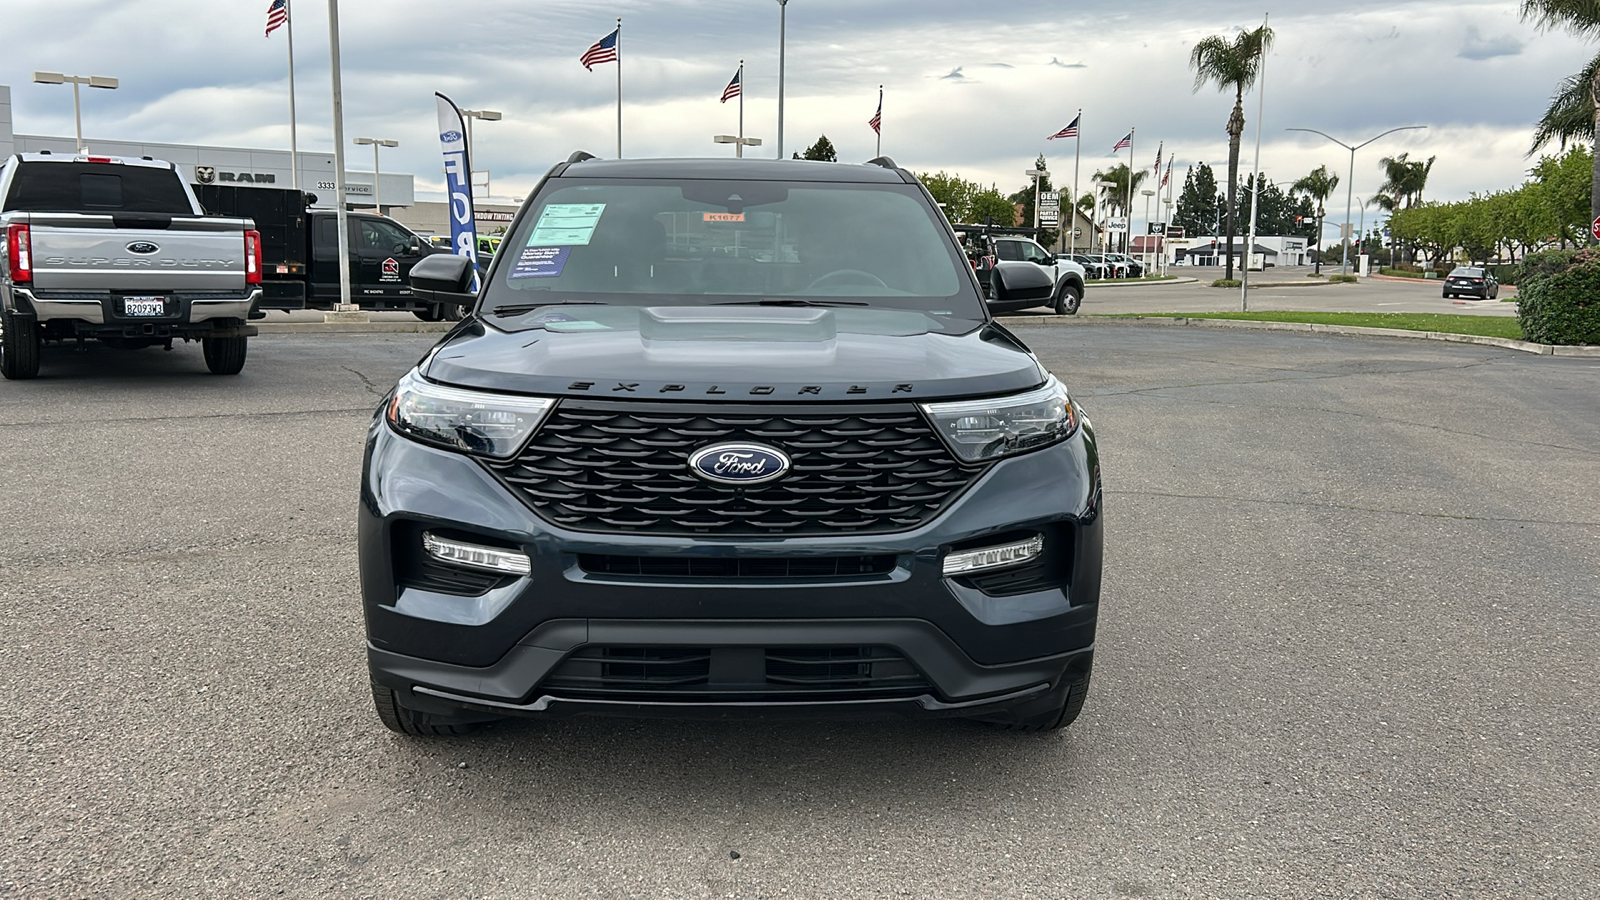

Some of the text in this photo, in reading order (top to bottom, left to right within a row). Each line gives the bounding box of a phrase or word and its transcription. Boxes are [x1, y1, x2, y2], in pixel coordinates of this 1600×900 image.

[219, 172, 275, 184] RAM
[317, 182, 335, 190] 3333
[1040, 192, 1059, 200] OEM
[1108, 222, 1126, 230] Jeep
[46, 257, 234, 267] SUPER DUTY
[568, 381, 913, 395] EXPLORER
[714, 452, 766, 474] Ford
